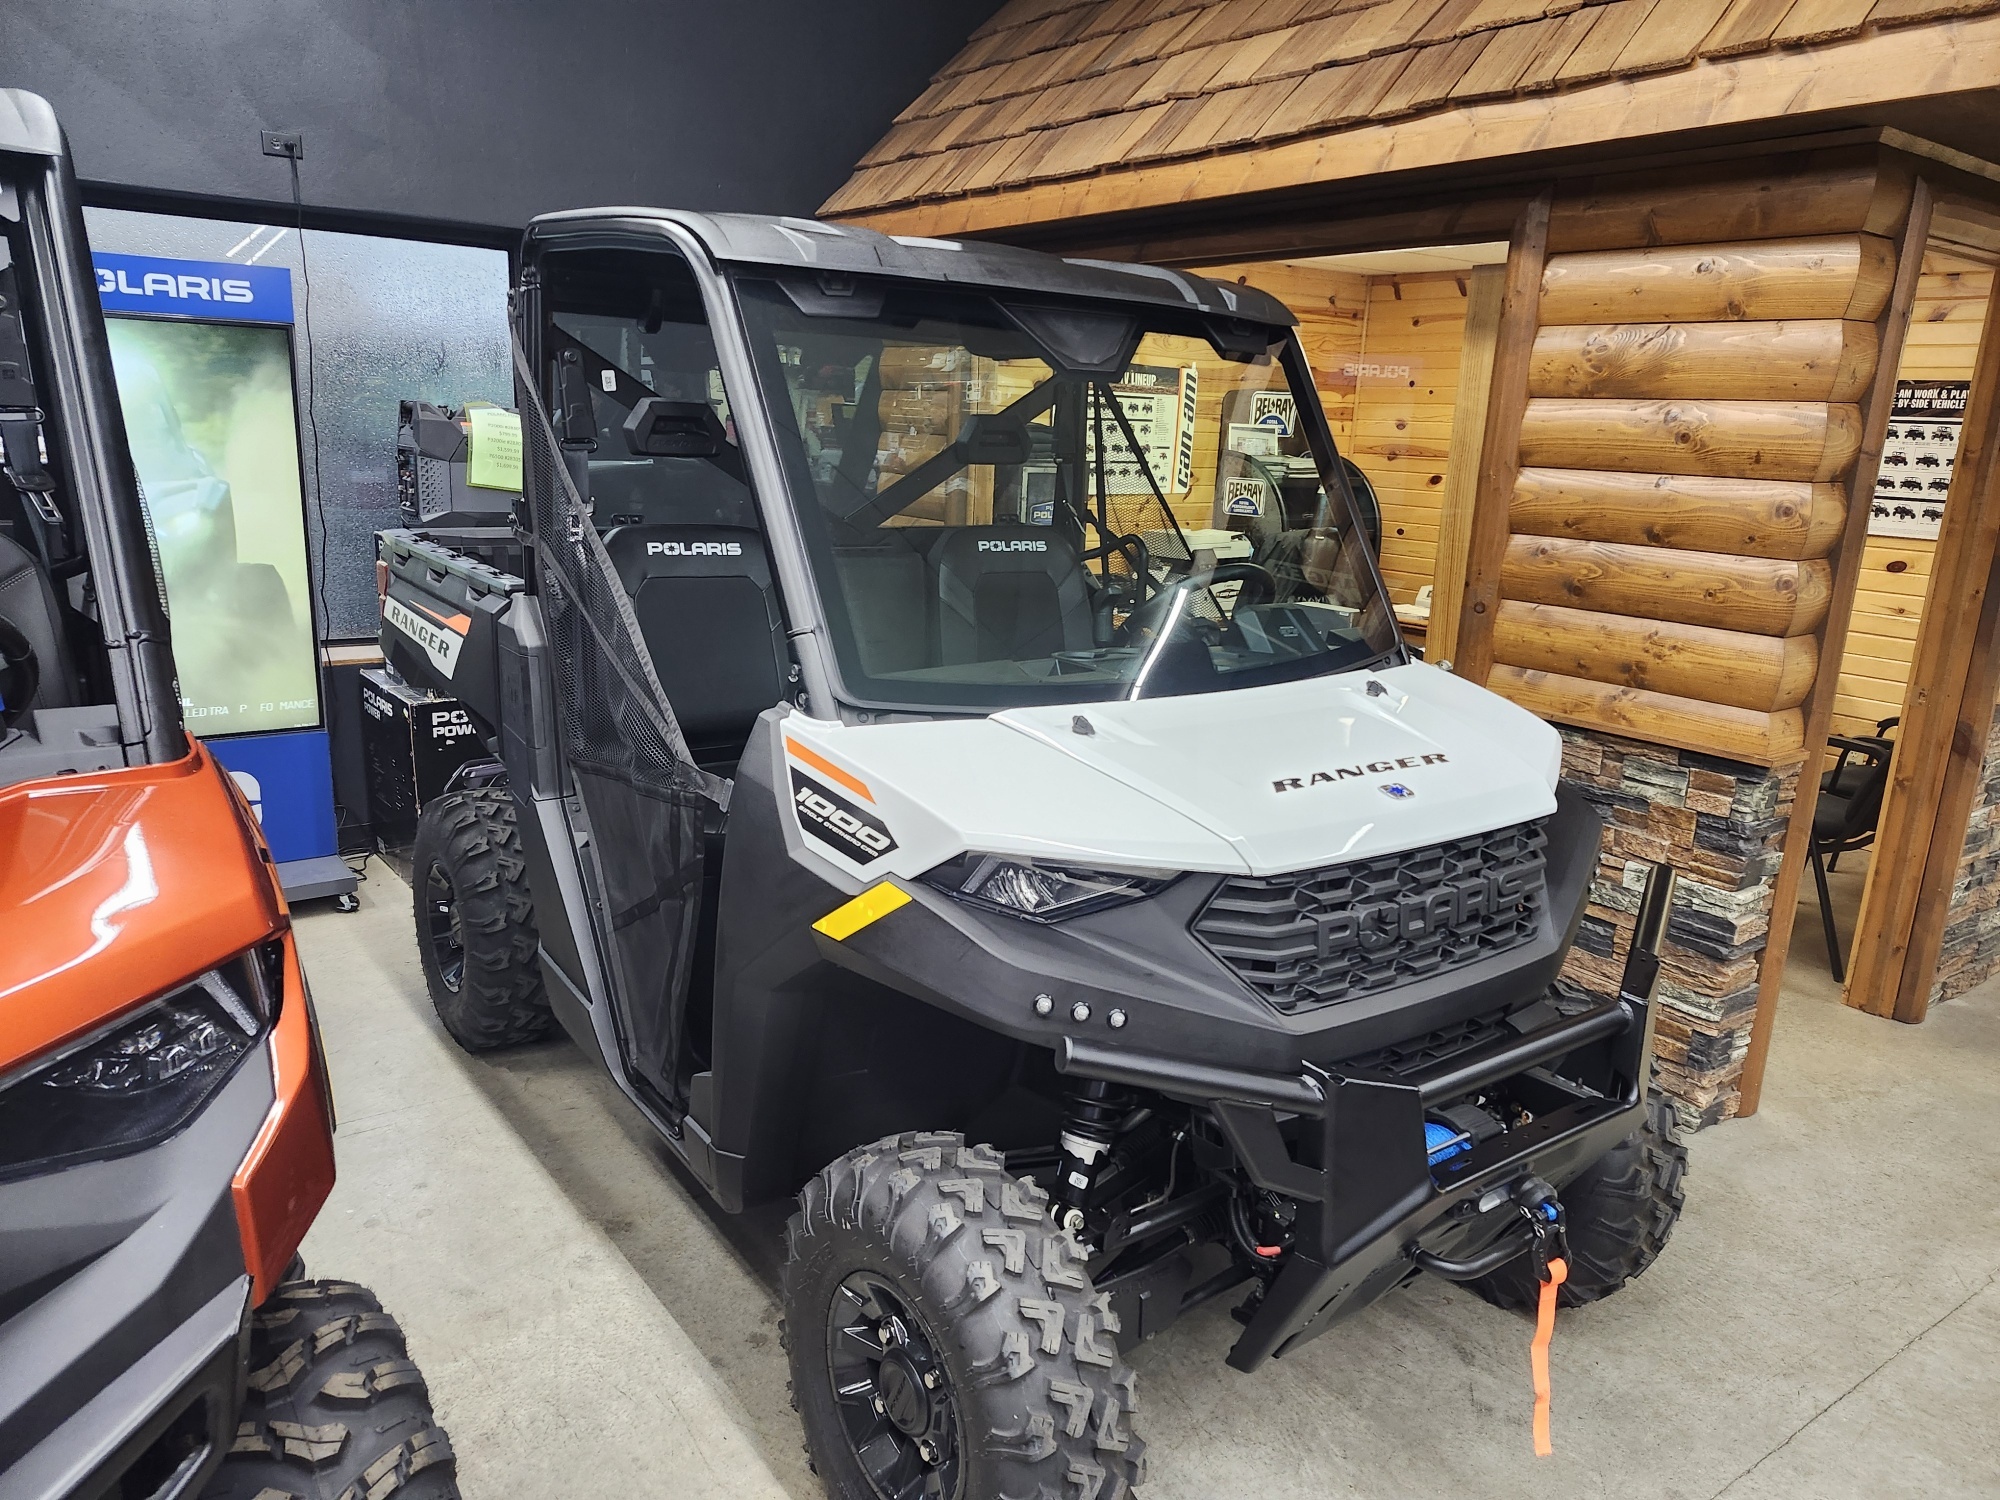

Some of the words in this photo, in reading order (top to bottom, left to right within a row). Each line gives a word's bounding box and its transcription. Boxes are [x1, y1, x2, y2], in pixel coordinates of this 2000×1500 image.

[1131, 371, 1157, 387] LINEUP
[1914, 388, 1941, 399] WORK
[1940, 389, 1948, 399] &
[1931, 399, 1966, 409] VEHICLE
[1177, 372, 1197, 489] can-am
[646, 541, 742, 556] POLARIS
[977, 540, 1048, 552] POLARIS
[391, 605, 451, 660] RANGER
[363, 687, 394, 718] POLARIS
[363, 701, 382, 721] POWER
[1271, 752, 1450, 794] RANGER
[794, 786, 892, 851] 1000
[1316, 869, 1526, 957] POLARIS
